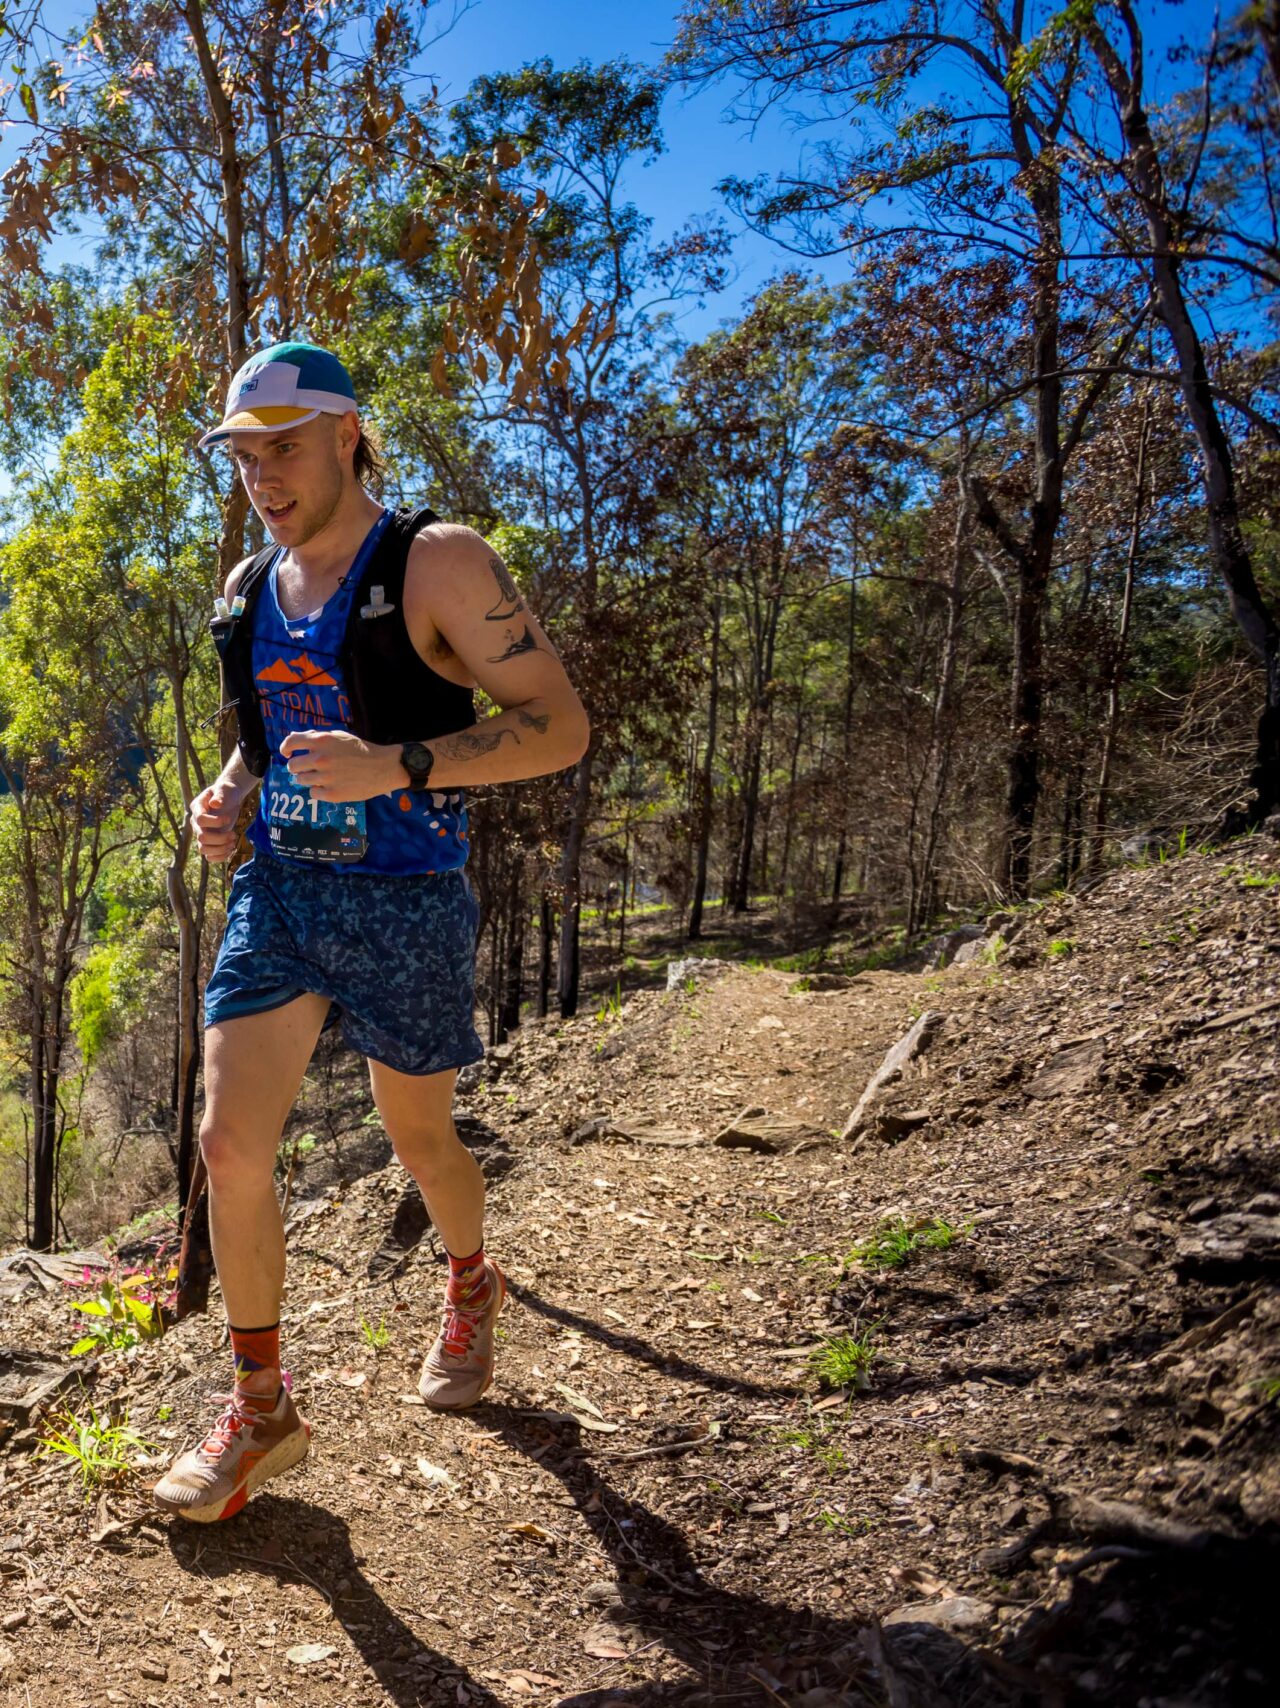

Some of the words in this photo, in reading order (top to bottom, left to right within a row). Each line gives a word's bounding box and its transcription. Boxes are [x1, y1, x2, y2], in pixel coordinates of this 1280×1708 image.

[280, 691, 333, 726] TRAIL
[270, 791, 318, 823] 2221
[270, 826, 281, 841] JIM
